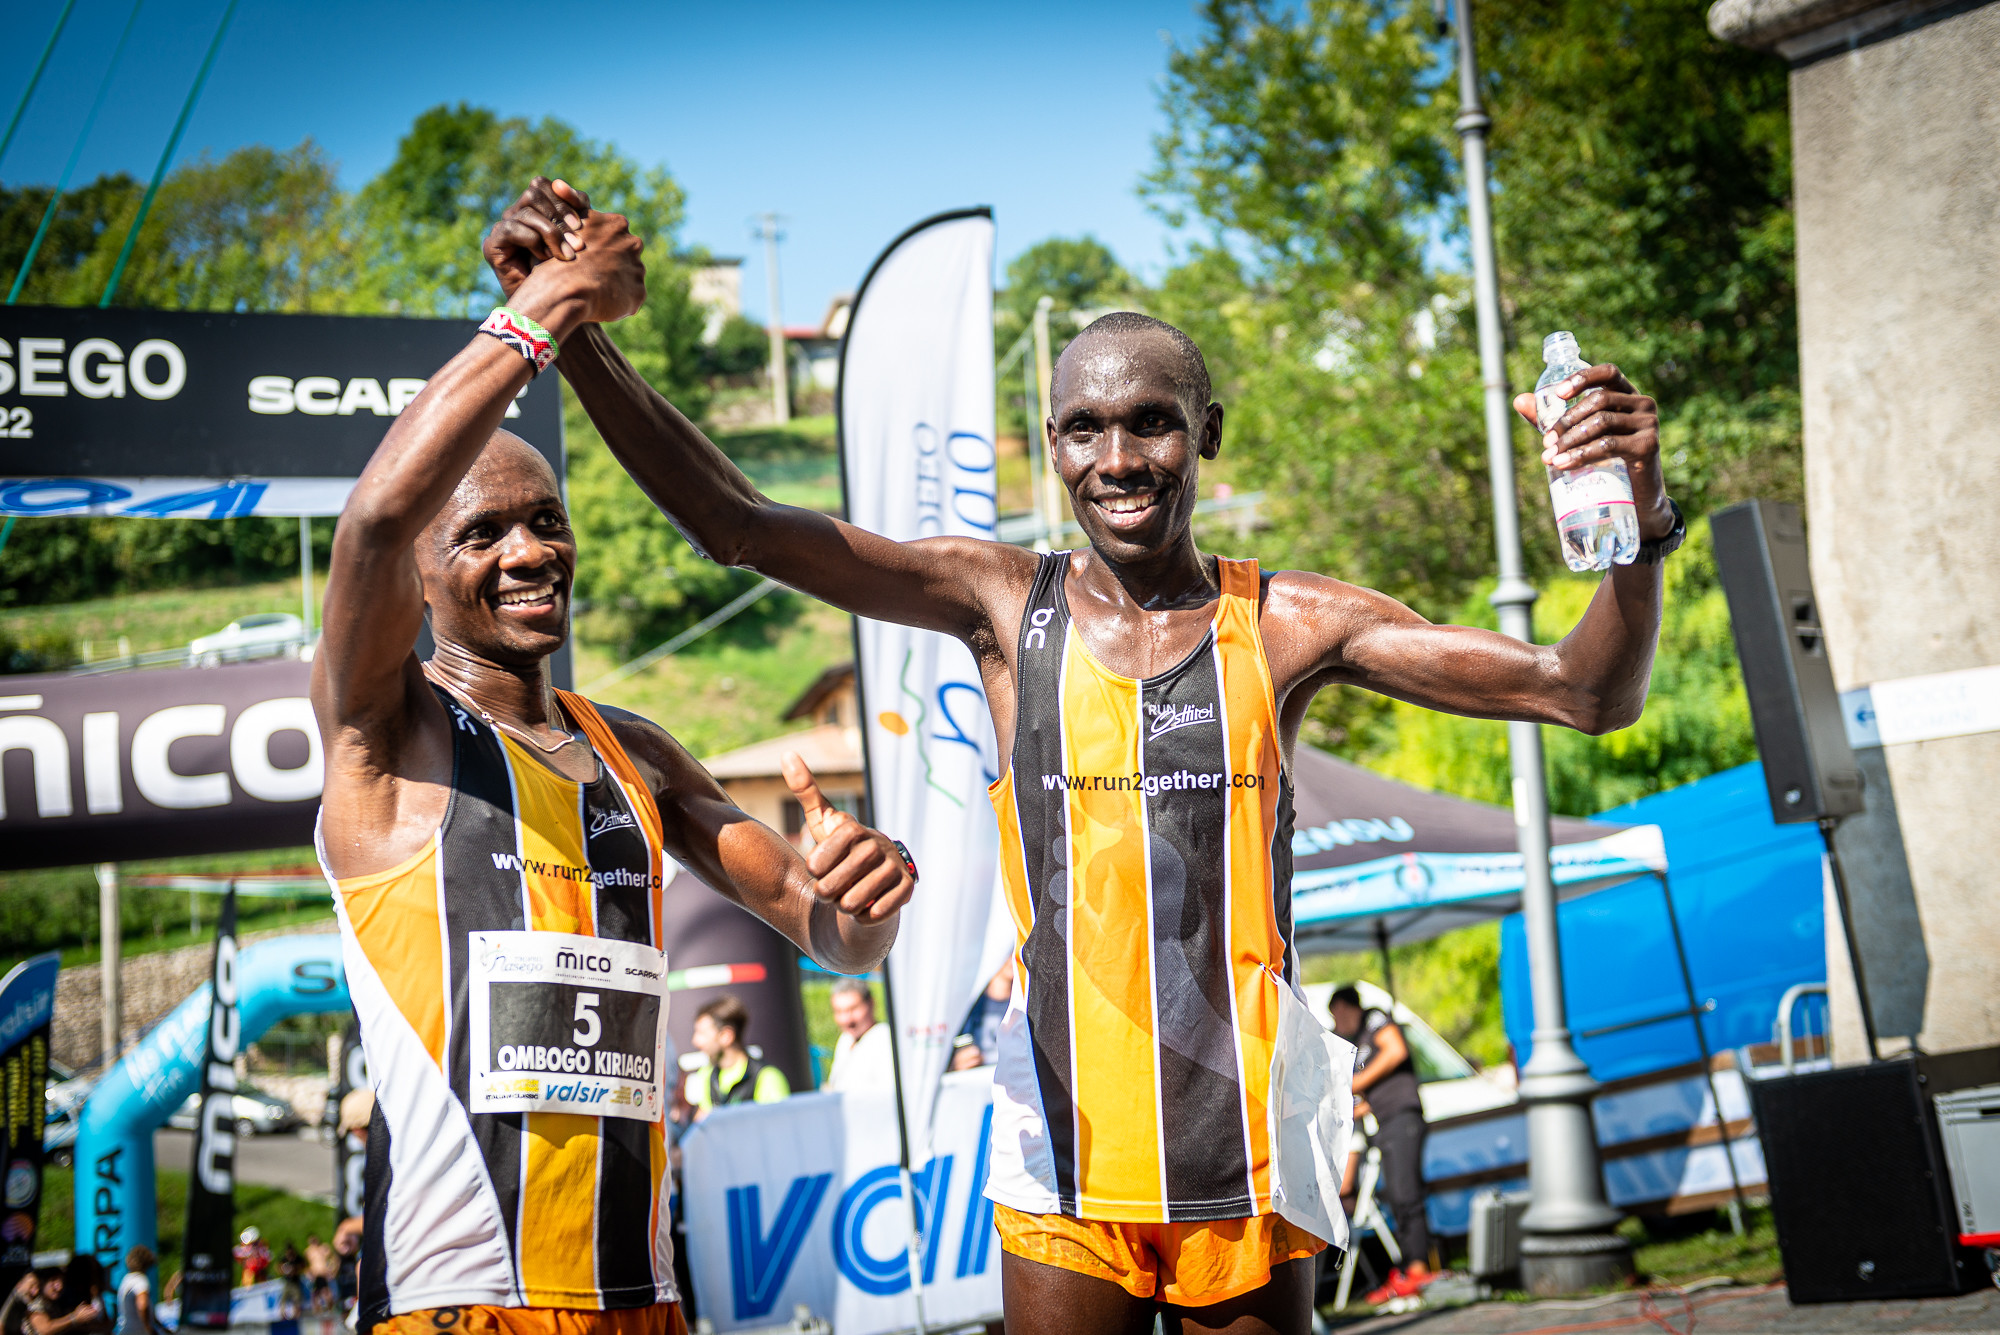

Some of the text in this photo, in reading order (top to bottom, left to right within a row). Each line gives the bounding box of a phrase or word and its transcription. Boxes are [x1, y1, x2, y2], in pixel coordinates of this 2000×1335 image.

[1148, 703, 1176, 716] RUN
[1150, 702, 1215, 736] Osttirol
[624, 967, 659, 981] SCARPA
[572, 991, 602, 1047] 5
[497, 1044, 651, 1081] OMBOGO KIRIAGO
[544, 1080, 610, 1104] valsir
